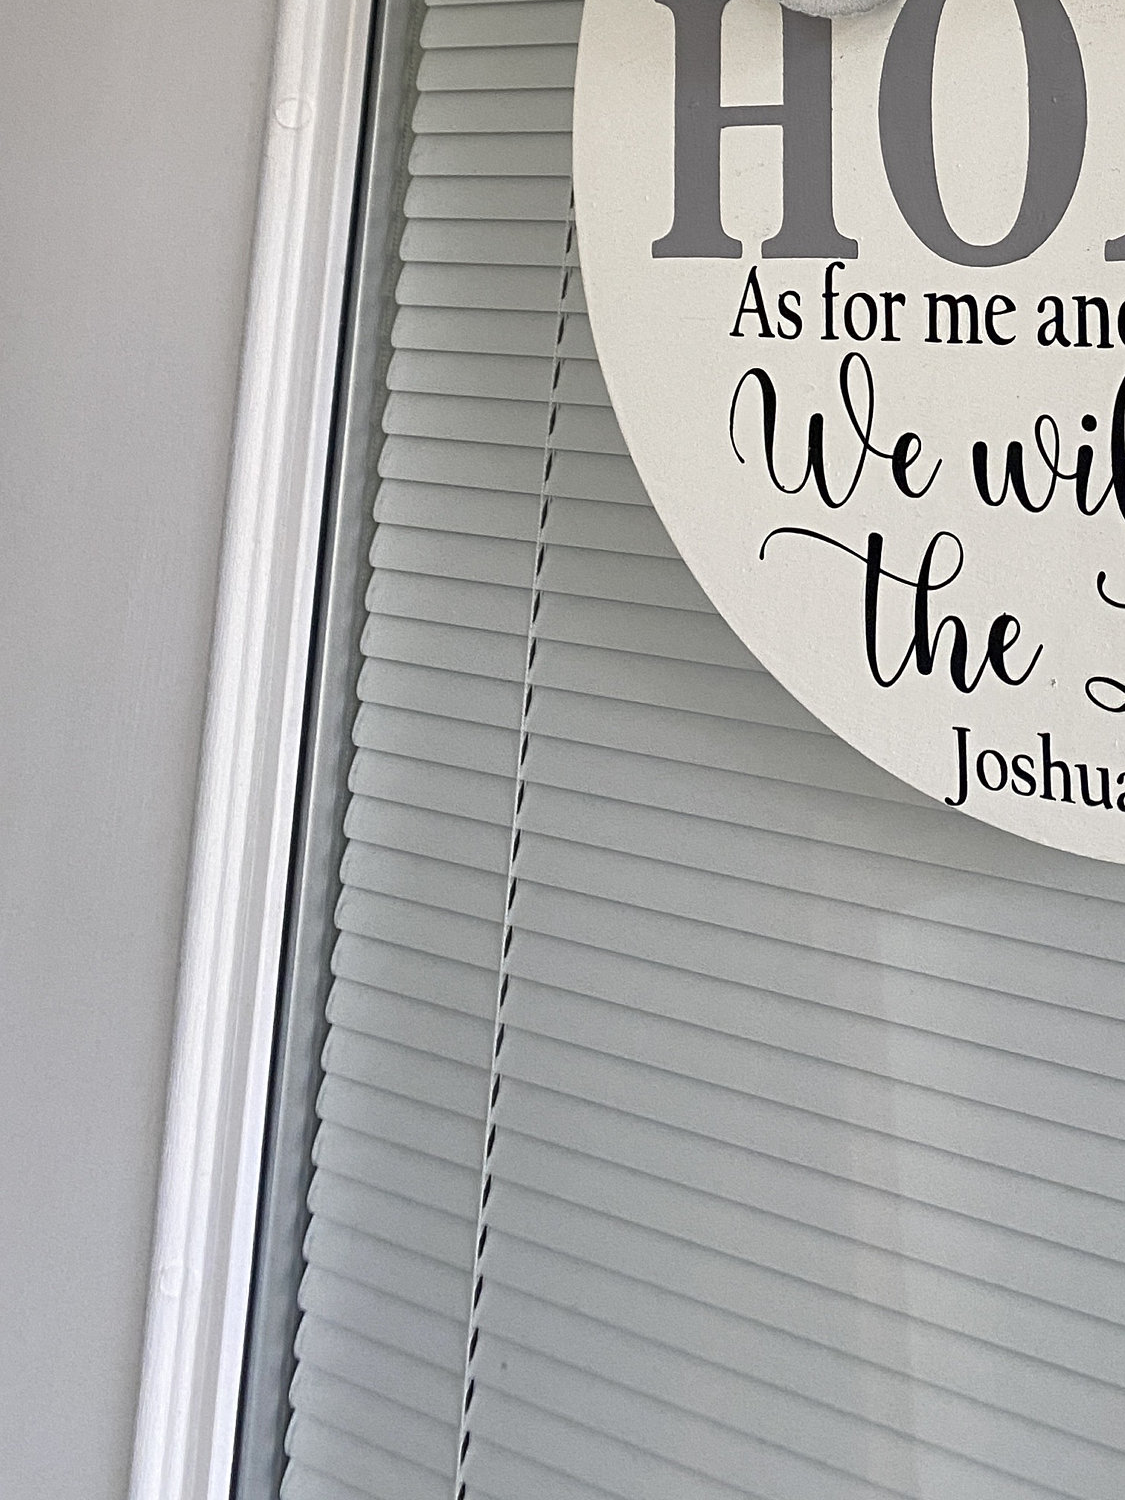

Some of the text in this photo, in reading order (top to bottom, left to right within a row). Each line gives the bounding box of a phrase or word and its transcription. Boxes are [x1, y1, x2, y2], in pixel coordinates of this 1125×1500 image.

[730, 263, 803, 340] As
[820, 262, 906, 343] for
[923, 292, 1017, 346] me
[729, 351, 943, 509] We
[758, 527, 1044, 694] the
